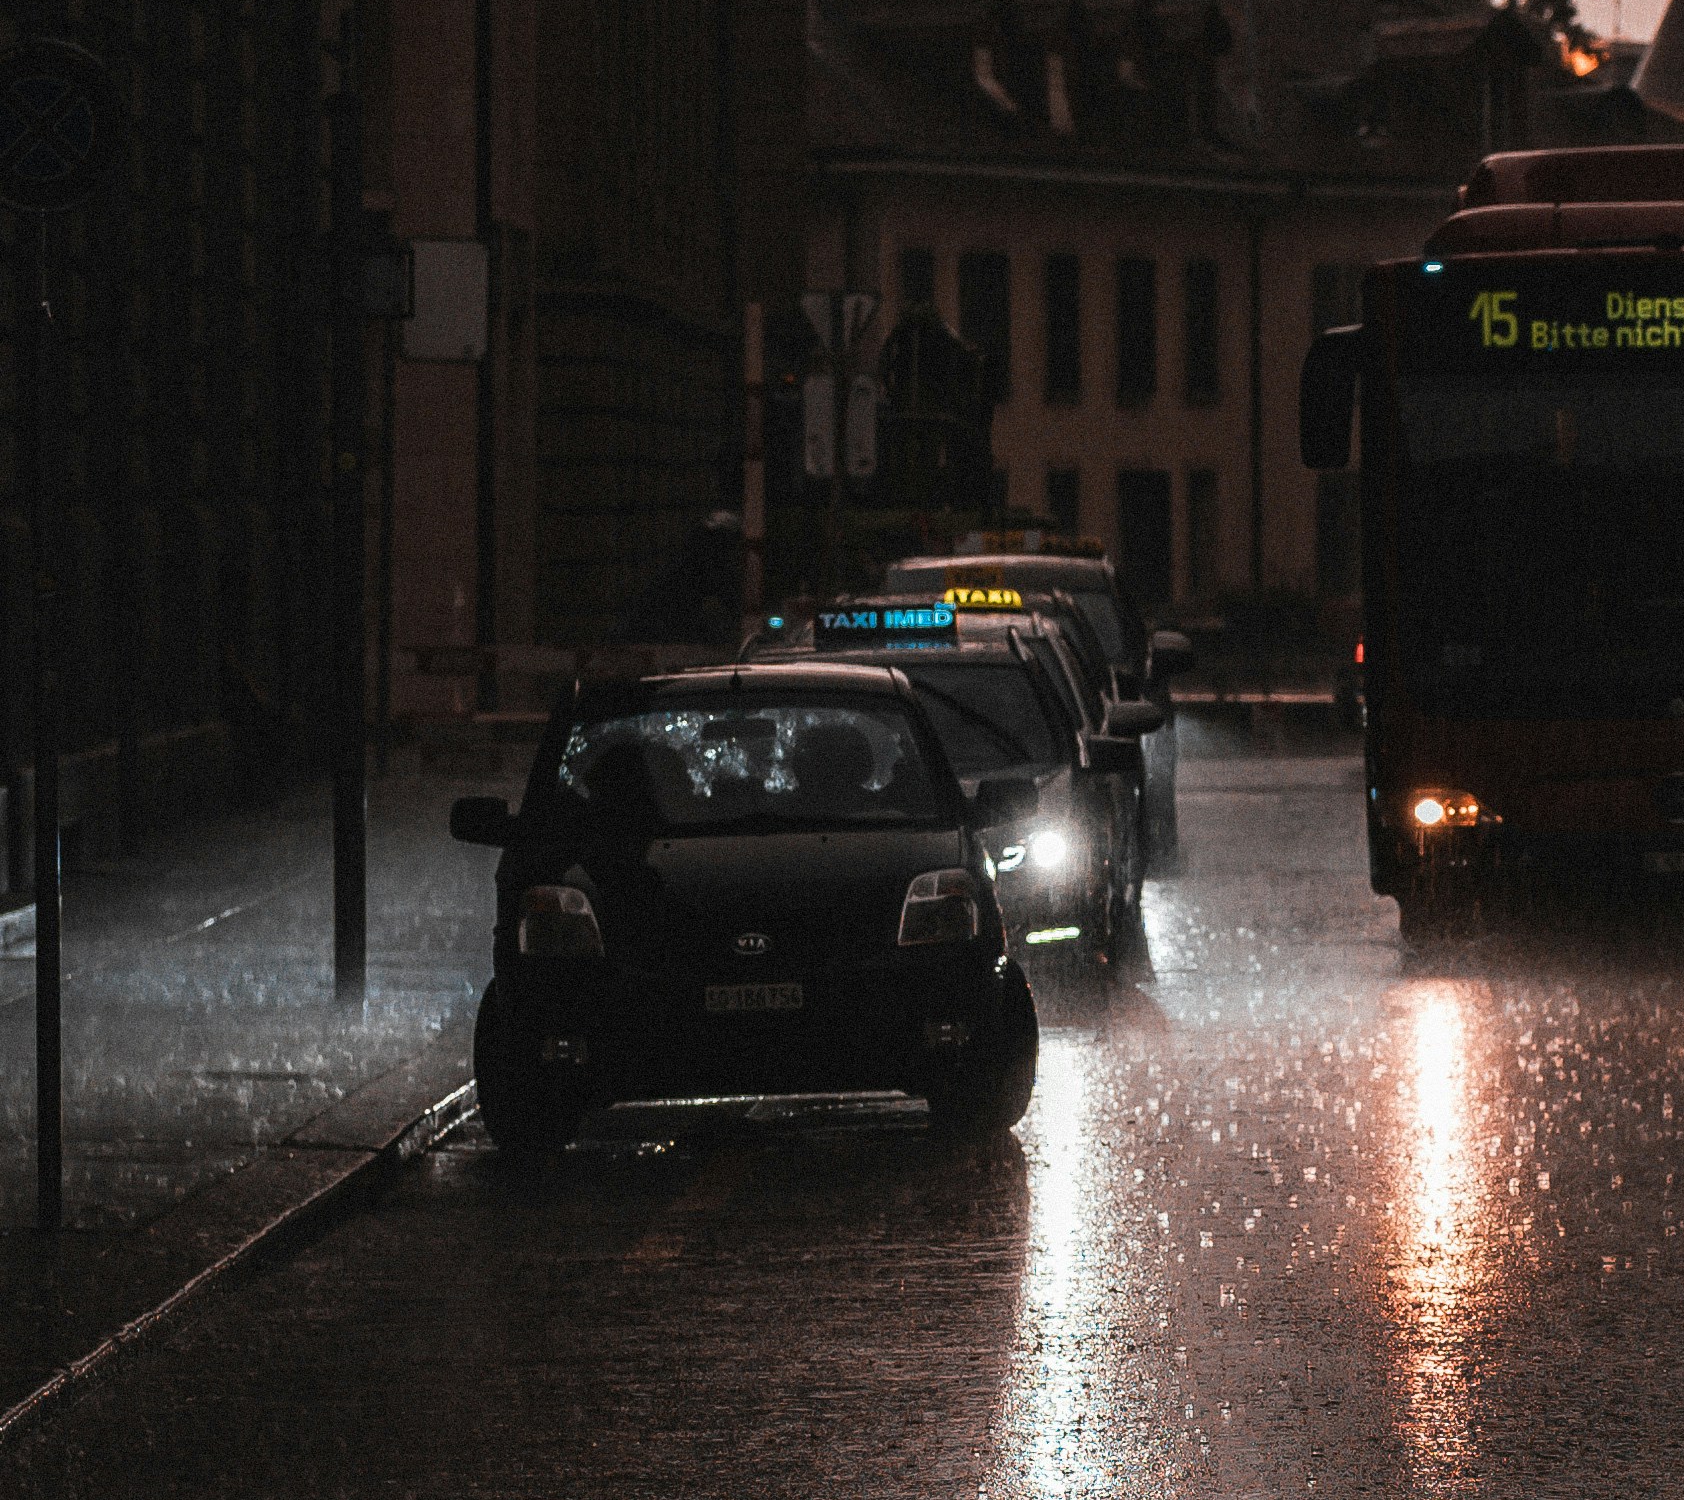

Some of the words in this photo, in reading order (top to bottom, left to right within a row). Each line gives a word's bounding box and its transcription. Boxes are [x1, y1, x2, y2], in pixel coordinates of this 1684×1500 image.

[1468, 290, 1519, 348] 15
[1530, 320, 1610, 349] Bitte
[954, 587, 1013, 604] TAXI
[819, 612, 878, 629] TAXI
